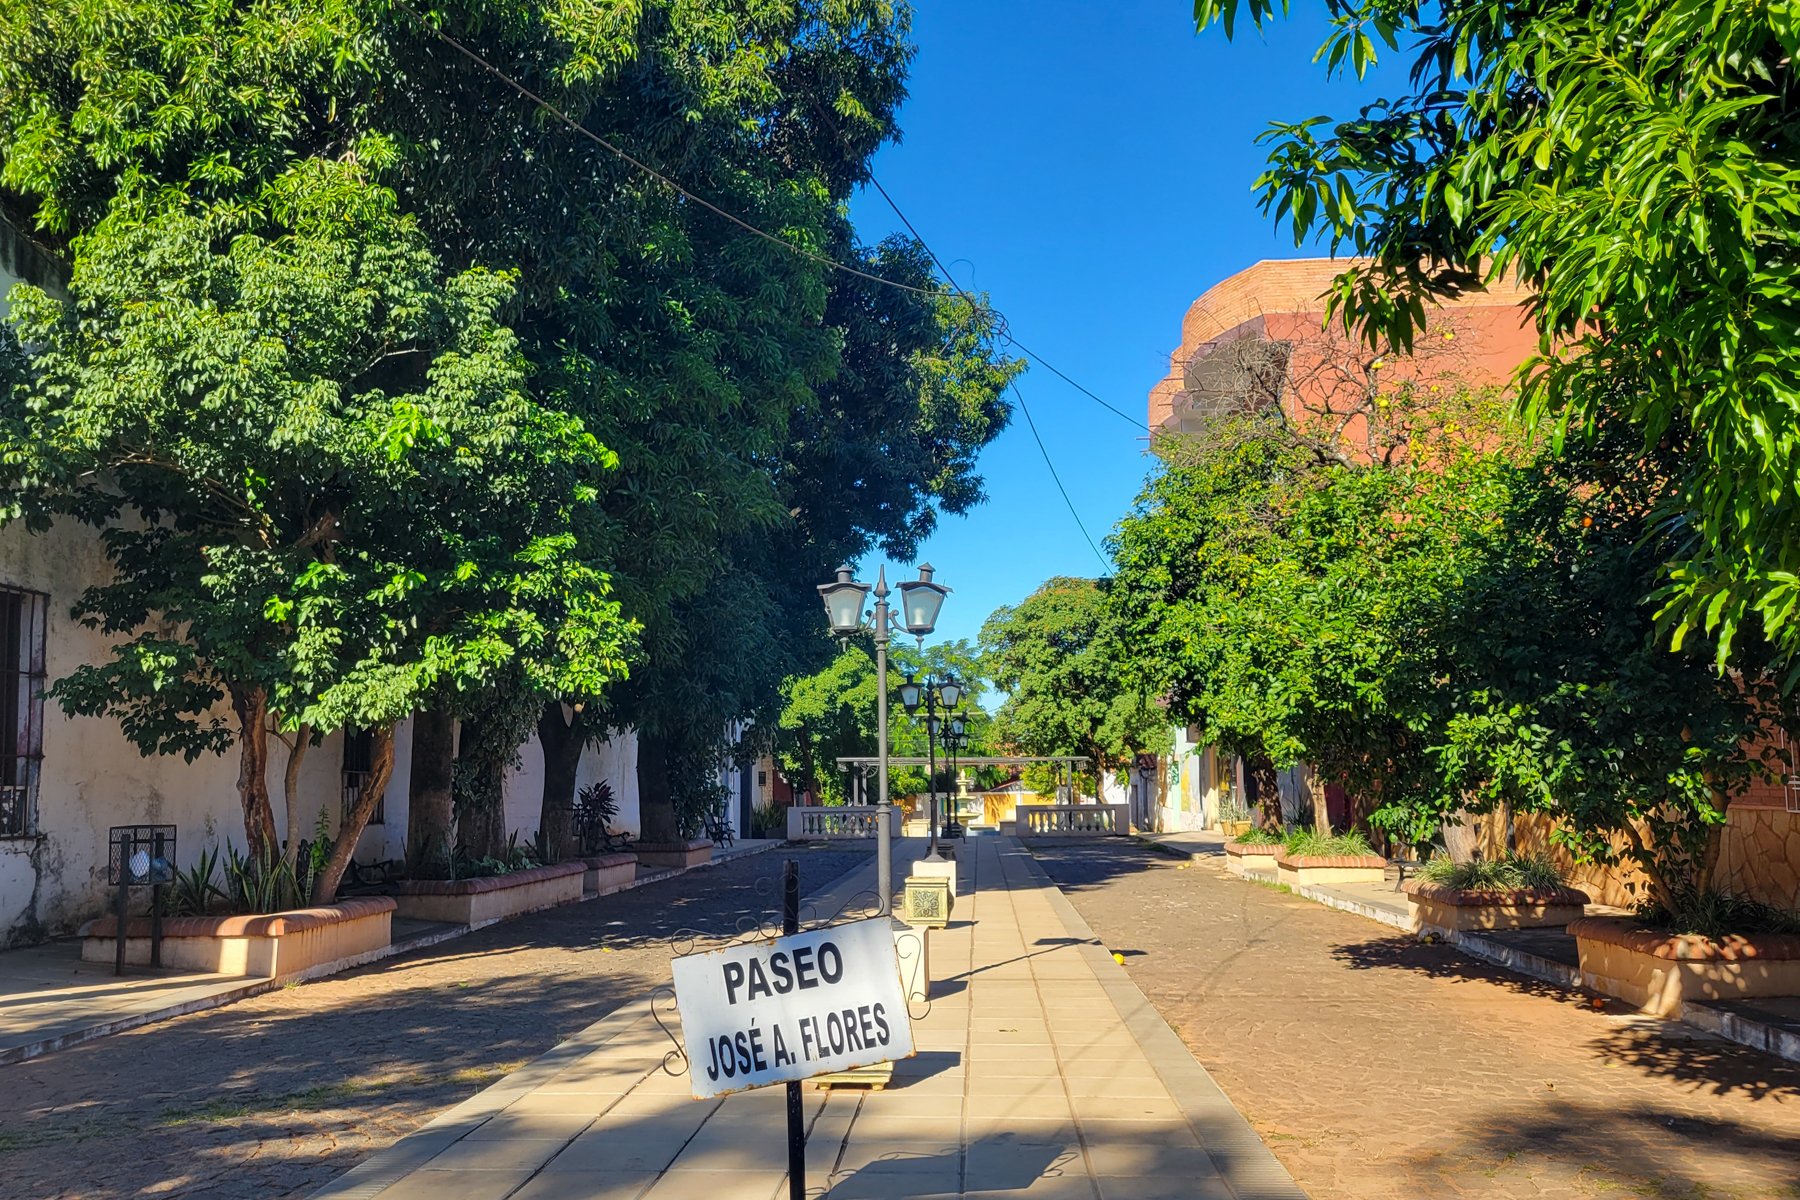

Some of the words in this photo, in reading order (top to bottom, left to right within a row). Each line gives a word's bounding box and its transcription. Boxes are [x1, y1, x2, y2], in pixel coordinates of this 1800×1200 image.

[722, 942, 843, 1005] PASEO
[707, 1018, 768, 1081] JOSÉ
[773, 1024, 796, 1068] A.
[799, 1003, 890, 1062] FLORES
